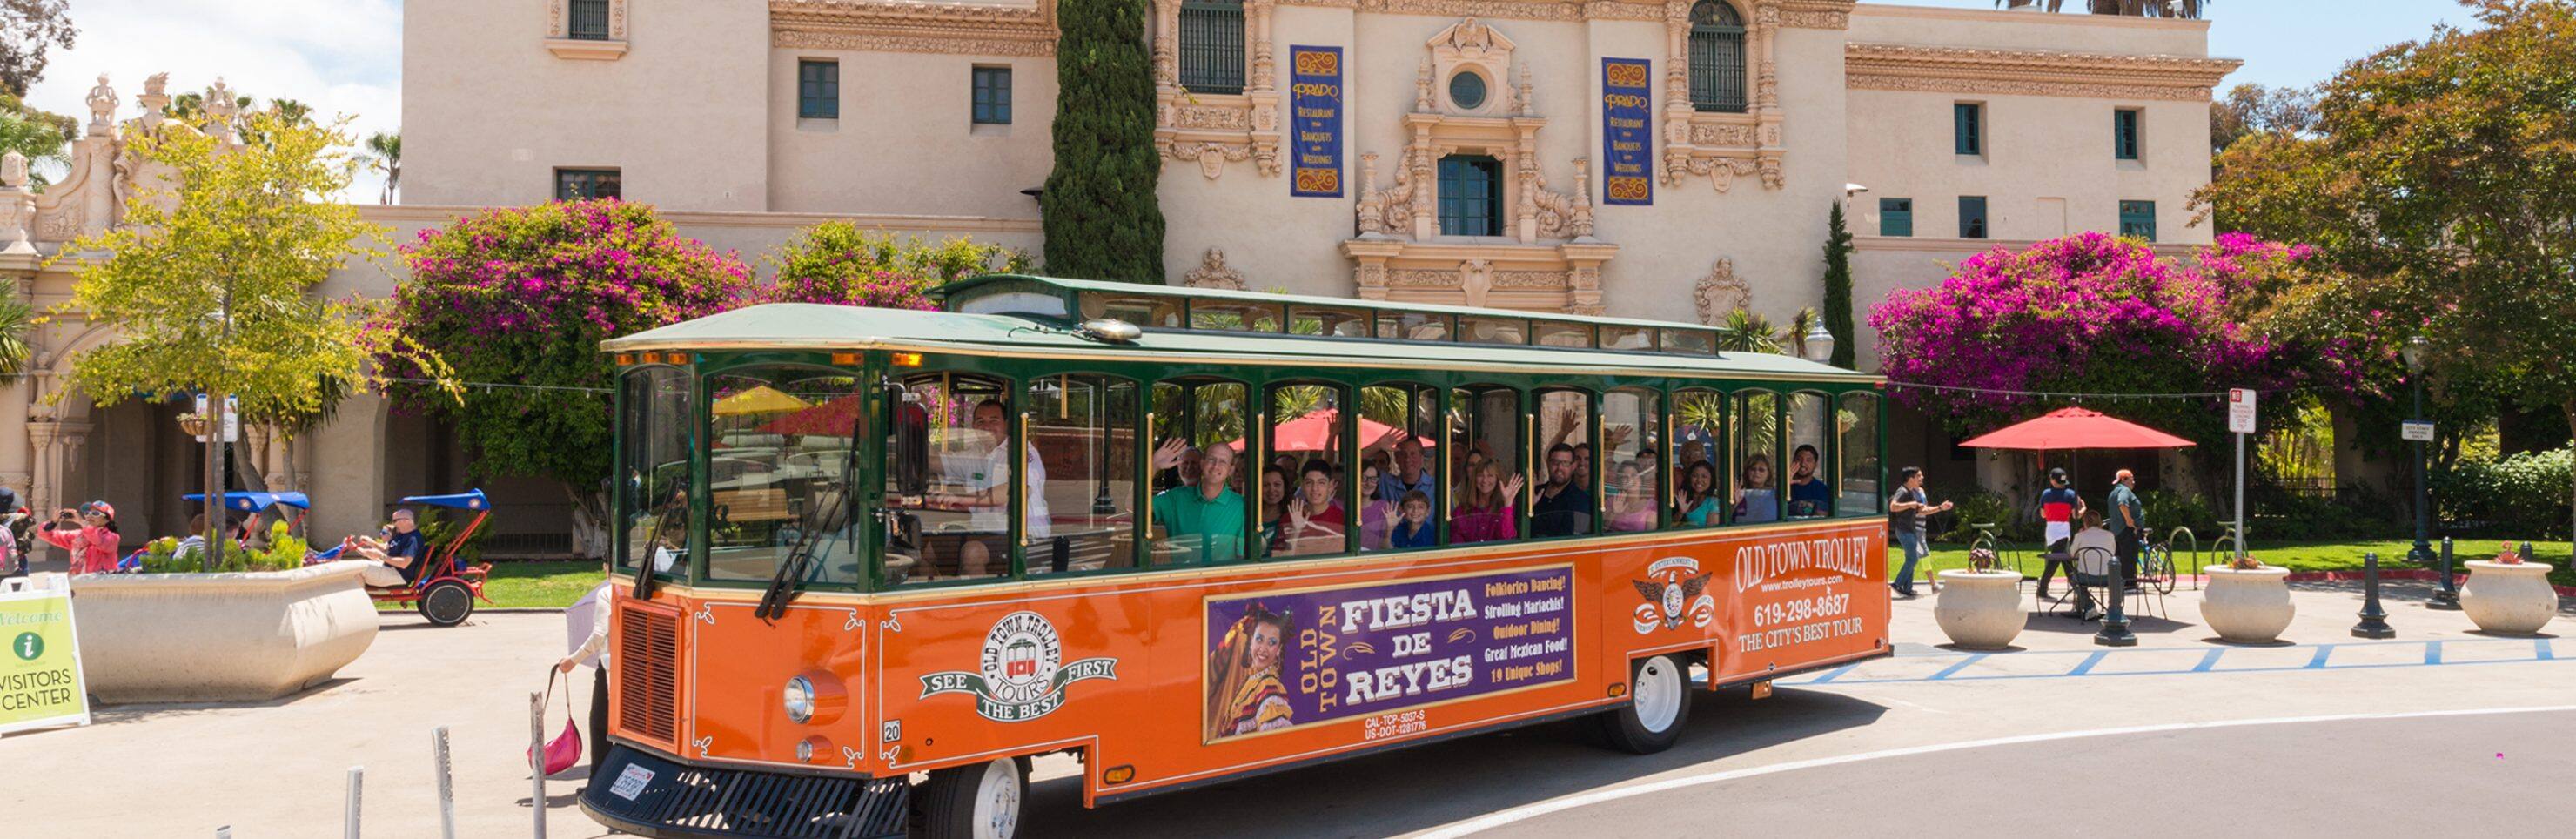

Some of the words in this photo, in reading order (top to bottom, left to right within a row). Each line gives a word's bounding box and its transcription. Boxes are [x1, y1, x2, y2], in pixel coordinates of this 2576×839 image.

[1292, 83, 1340, 101] PRADO
[1734, 545, 1766, 594] OLD
[1768, 540, 1811, 578] TOWN
[1814, 536, 1868, 579] TROLLEY
[1486, 581, 1529, 598] Folklorico
[1531, 575, 1566, 592] Dancing!
[1761, 574, 1844, 593] www.trolleytours.com
[1341, 588, 1478, 634] FIESTA
[1485, 601, 1521, 620] Strolling
[1524, 596, 1564, 614] Mariachis!
[1754, 593, 1850, 627] 619-298-8687
[1493, 624, 1528, 640] Outdoor
[1531, 618, 1560, 634] Dining!
[1738, 633, 1763, 653] THE
[1765, 626, 1802, 648] CITY'S
[1803, 622, 1831, 642] BEST
[1833, 616, 1863, 637] TOUR
[983, 648, 998, 672] OLD
[991, 614, 1023, 645] TOWN
[1027, 614, 1059, 665] TROLLEY
[1392, 632, 1432, 658] DE
[1485, 645, 1508, 662] Great
[1510, 642, 1543, 659] Mexican
[1545, 637, 1567, 654] Food!
[1067, 661, 1112, 681] FIRST
[1299, 628, 1318, 695] OLD
[1319, 605, 1338, 713] TOWN
[1491, 668, 1503, 683] 19
[1506, 665, 1533, 681] Unique
[1536, 659, 1562, 676] Shops!
[931, 675, 967, 692] SEE
[994, 675, 1050, 702] TOURS
[1345, 654, 1474, 706] REYES
[2, 688, 71, 711] CENTER
[982, 699, 1014, 720] THE
[1018, 690, 1062, 720] BEST
[885, 725, 899, 740] 20
